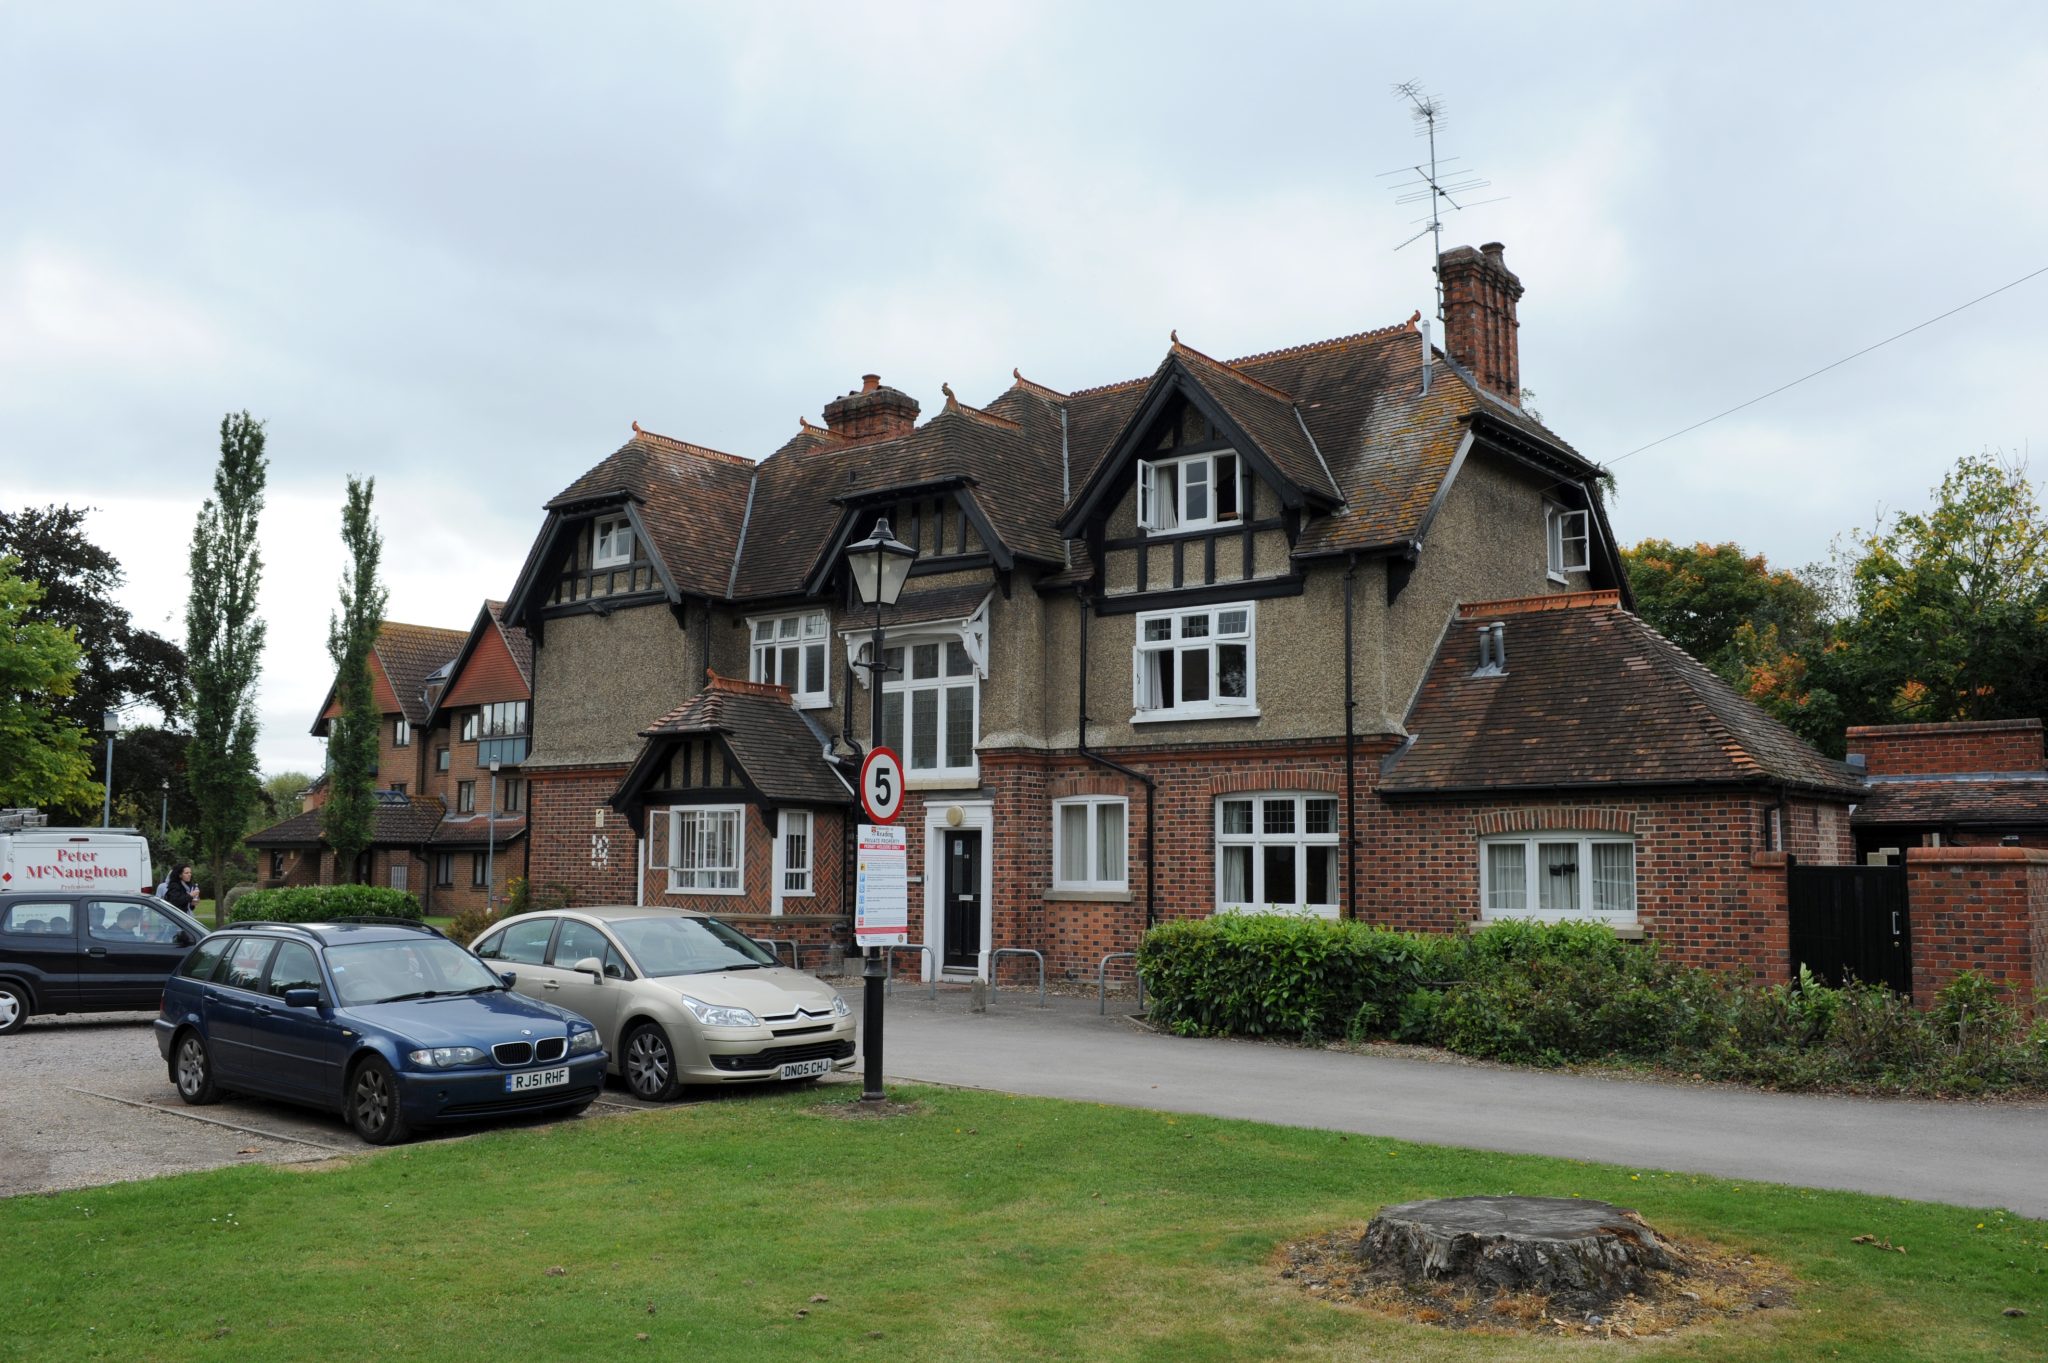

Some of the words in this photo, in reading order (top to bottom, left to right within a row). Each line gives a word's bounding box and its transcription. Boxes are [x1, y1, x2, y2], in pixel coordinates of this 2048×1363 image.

[875, 768, 891, 806] 5
[56, 849, 98, 862] Peter
[26, 865, 128, 880] McNaughton
[784, 1065, 809, 1077] DN05
[811, 1060, 829, 1073] CHJ
[516, 1074, 542, 1088] RJ51
[545, 1070, 565, 1085] RHF
